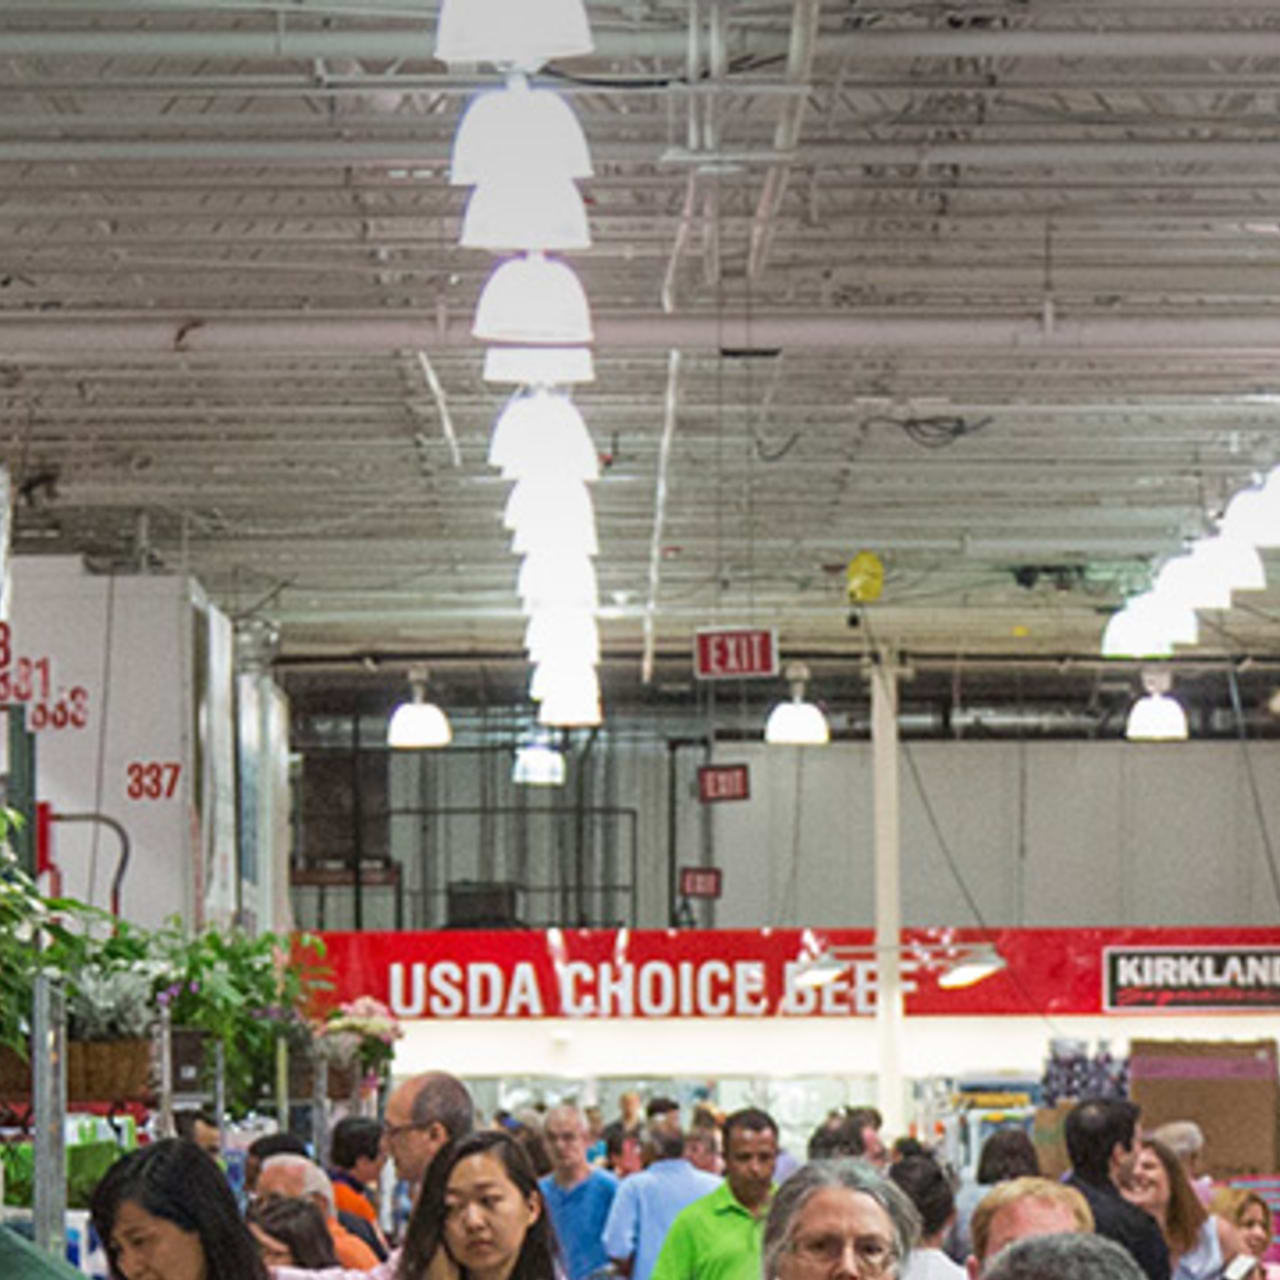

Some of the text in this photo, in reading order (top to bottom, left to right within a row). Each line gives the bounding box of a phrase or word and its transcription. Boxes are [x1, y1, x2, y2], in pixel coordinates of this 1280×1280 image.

[709, 634, 764, 673] EXIT
[127, 762, 182, 800] 337
[389, 962, 542, 1016] USDA
[562, 961, 767, 1016] CHOICE
